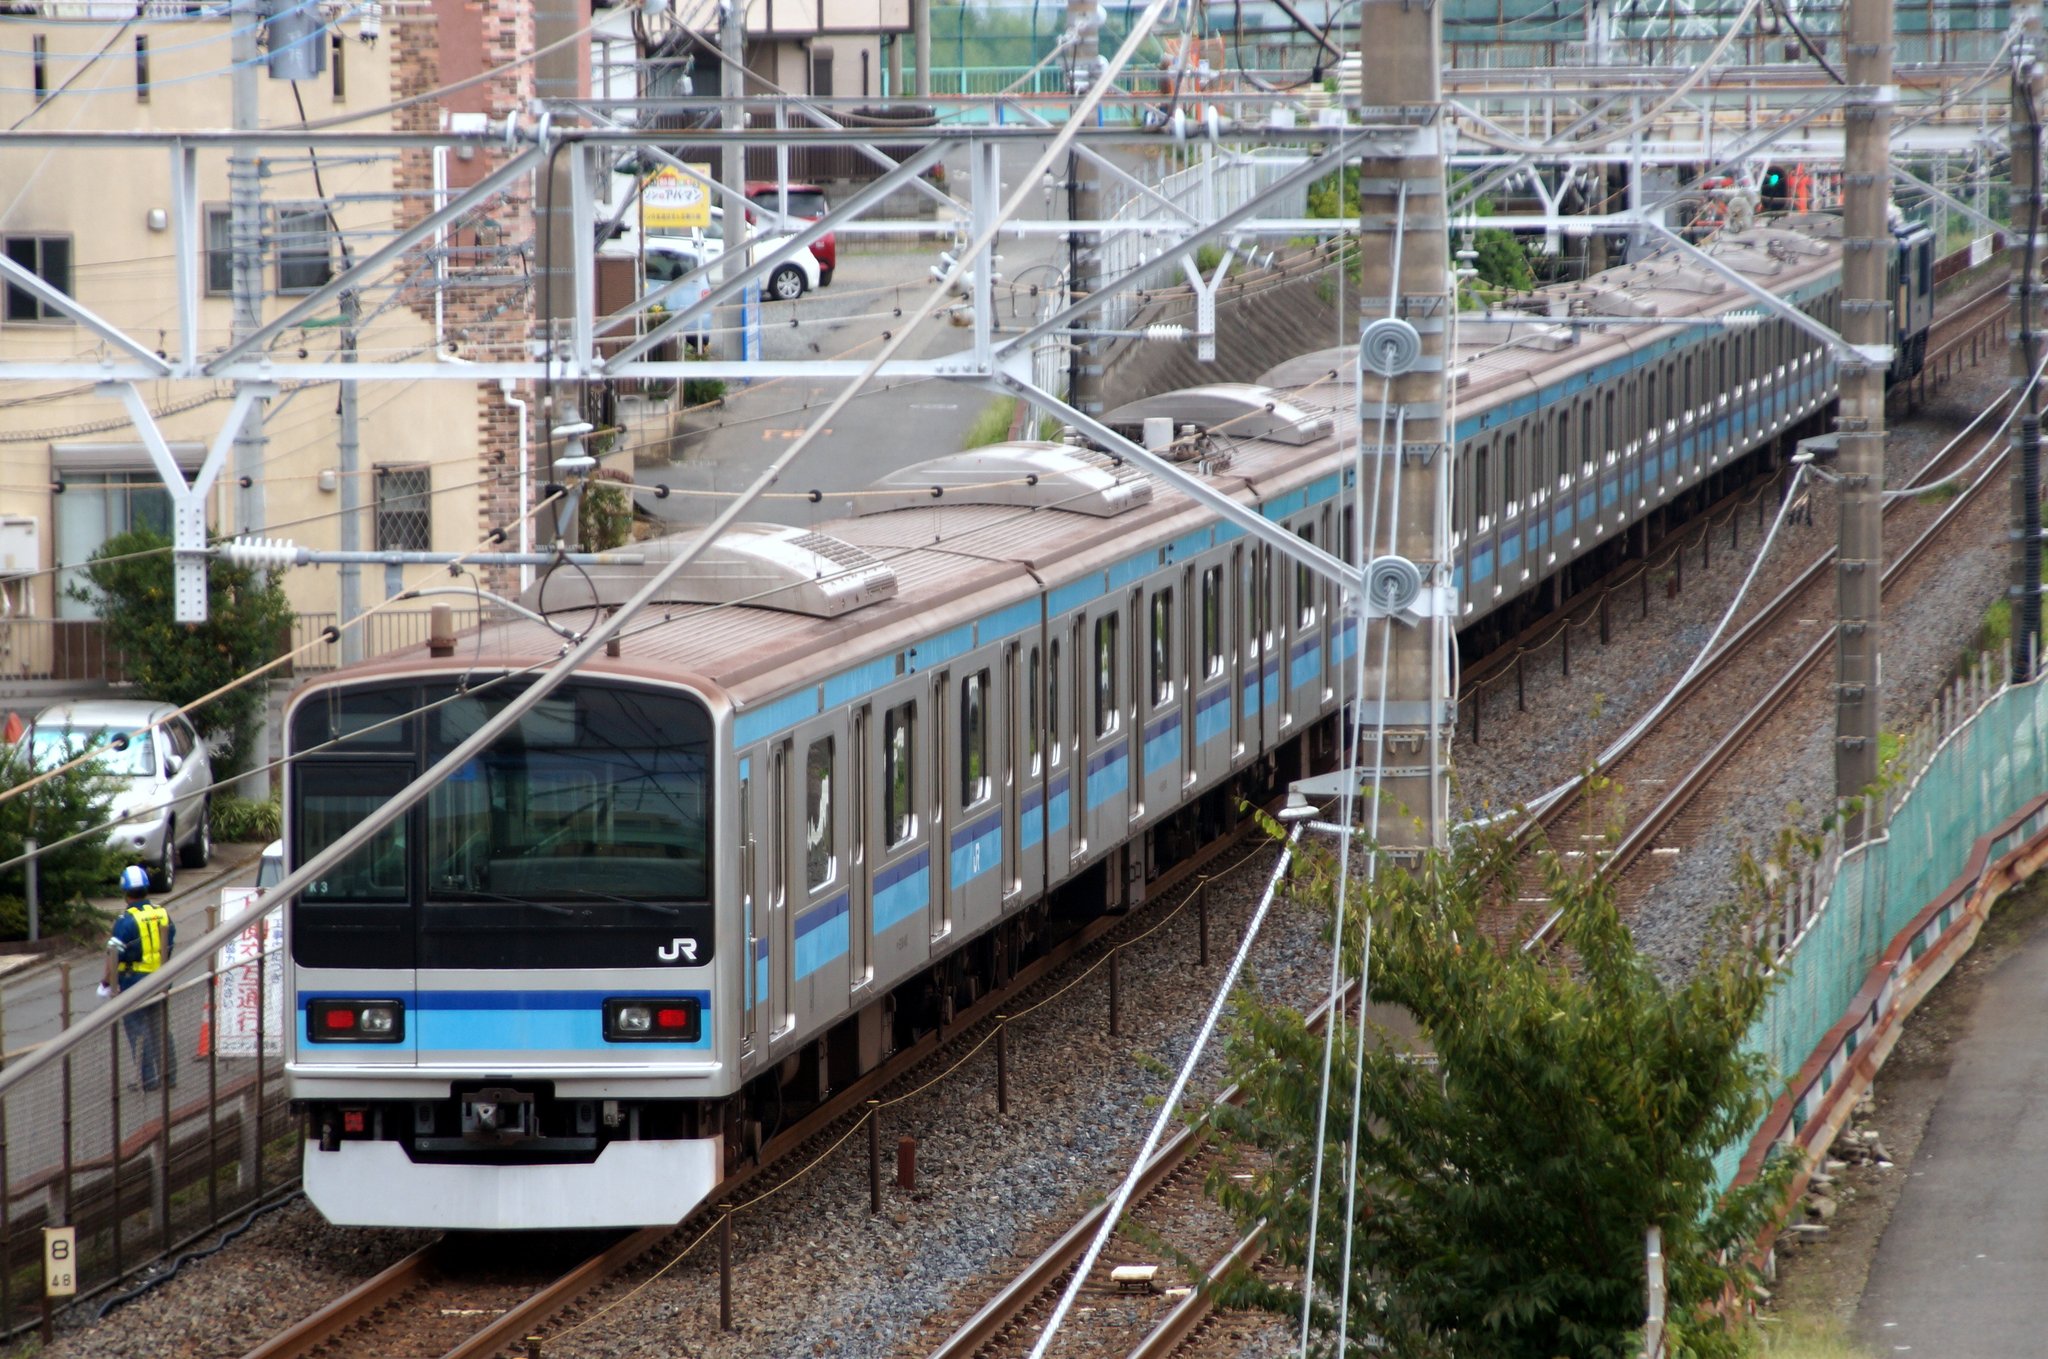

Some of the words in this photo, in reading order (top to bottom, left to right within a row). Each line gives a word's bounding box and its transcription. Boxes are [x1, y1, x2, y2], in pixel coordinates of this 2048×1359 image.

[973, 842, 980, 873] JR
[658, 938, 697, 960] JR
[52, 1240, 69, 1260] 8
